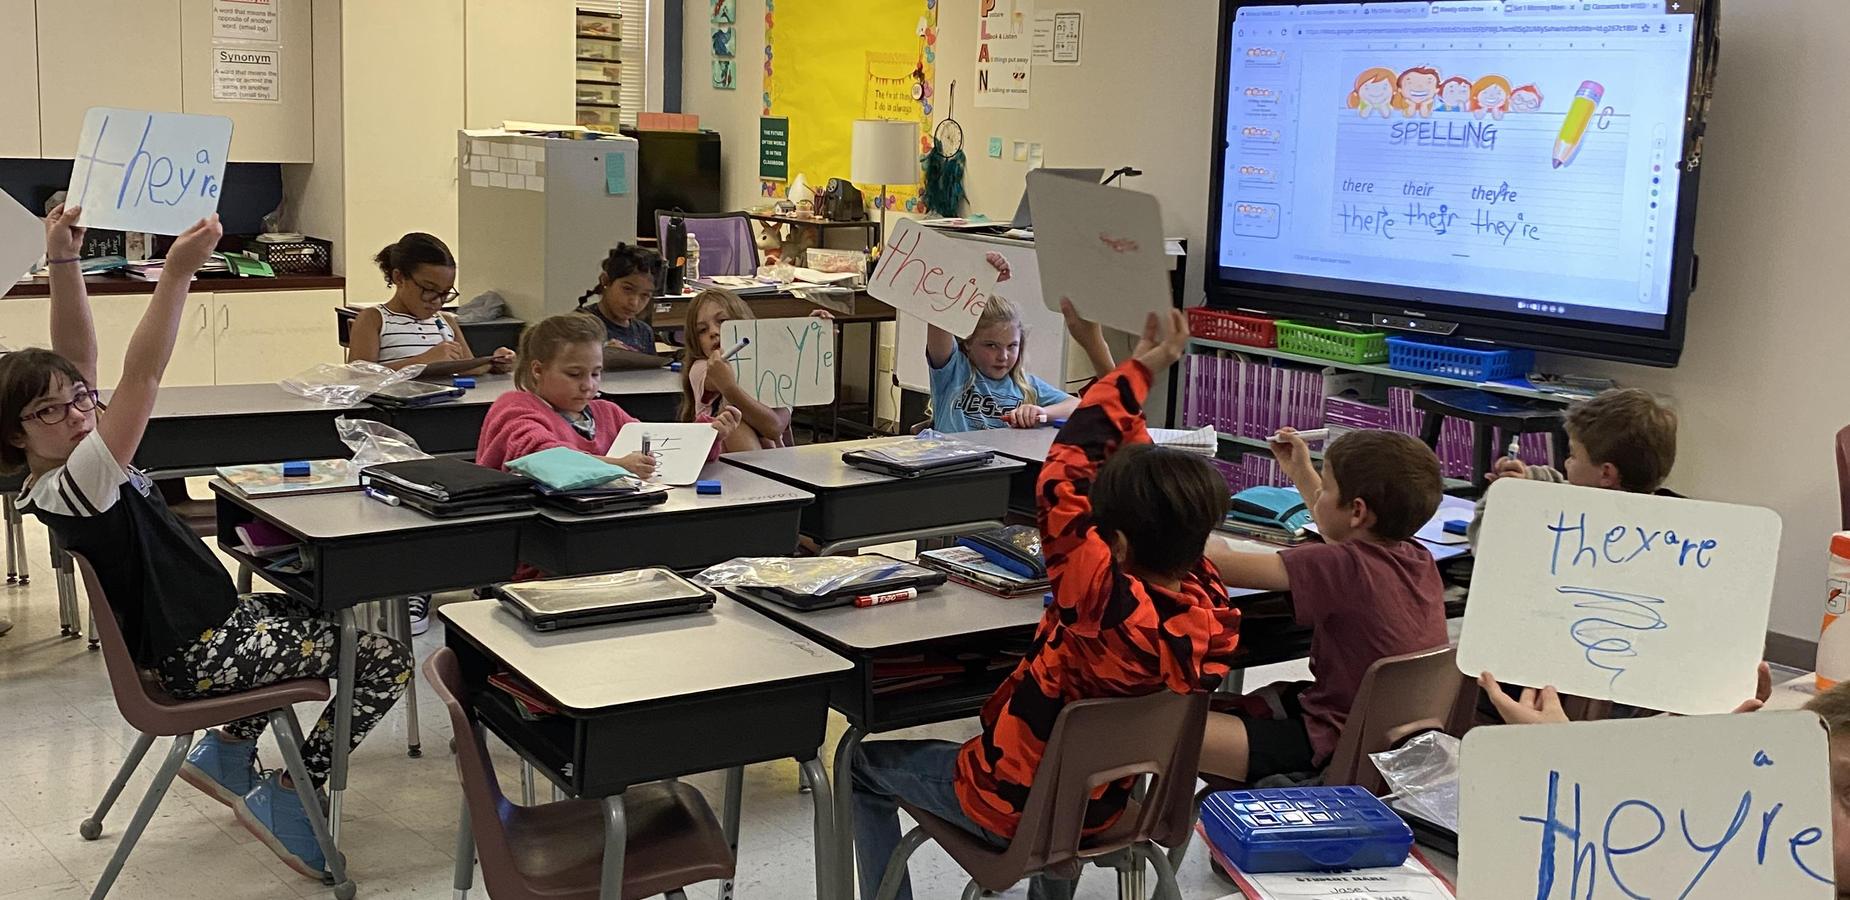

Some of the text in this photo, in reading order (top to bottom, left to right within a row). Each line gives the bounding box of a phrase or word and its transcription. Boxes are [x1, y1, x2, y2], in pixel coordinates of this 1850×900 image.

[220, 51, 271, 65] Synonym
[1390, 120, 1498, 147] SPELLING
[1343, 179, 1374, 193] there
[1403, 181, 1434, 197] their
